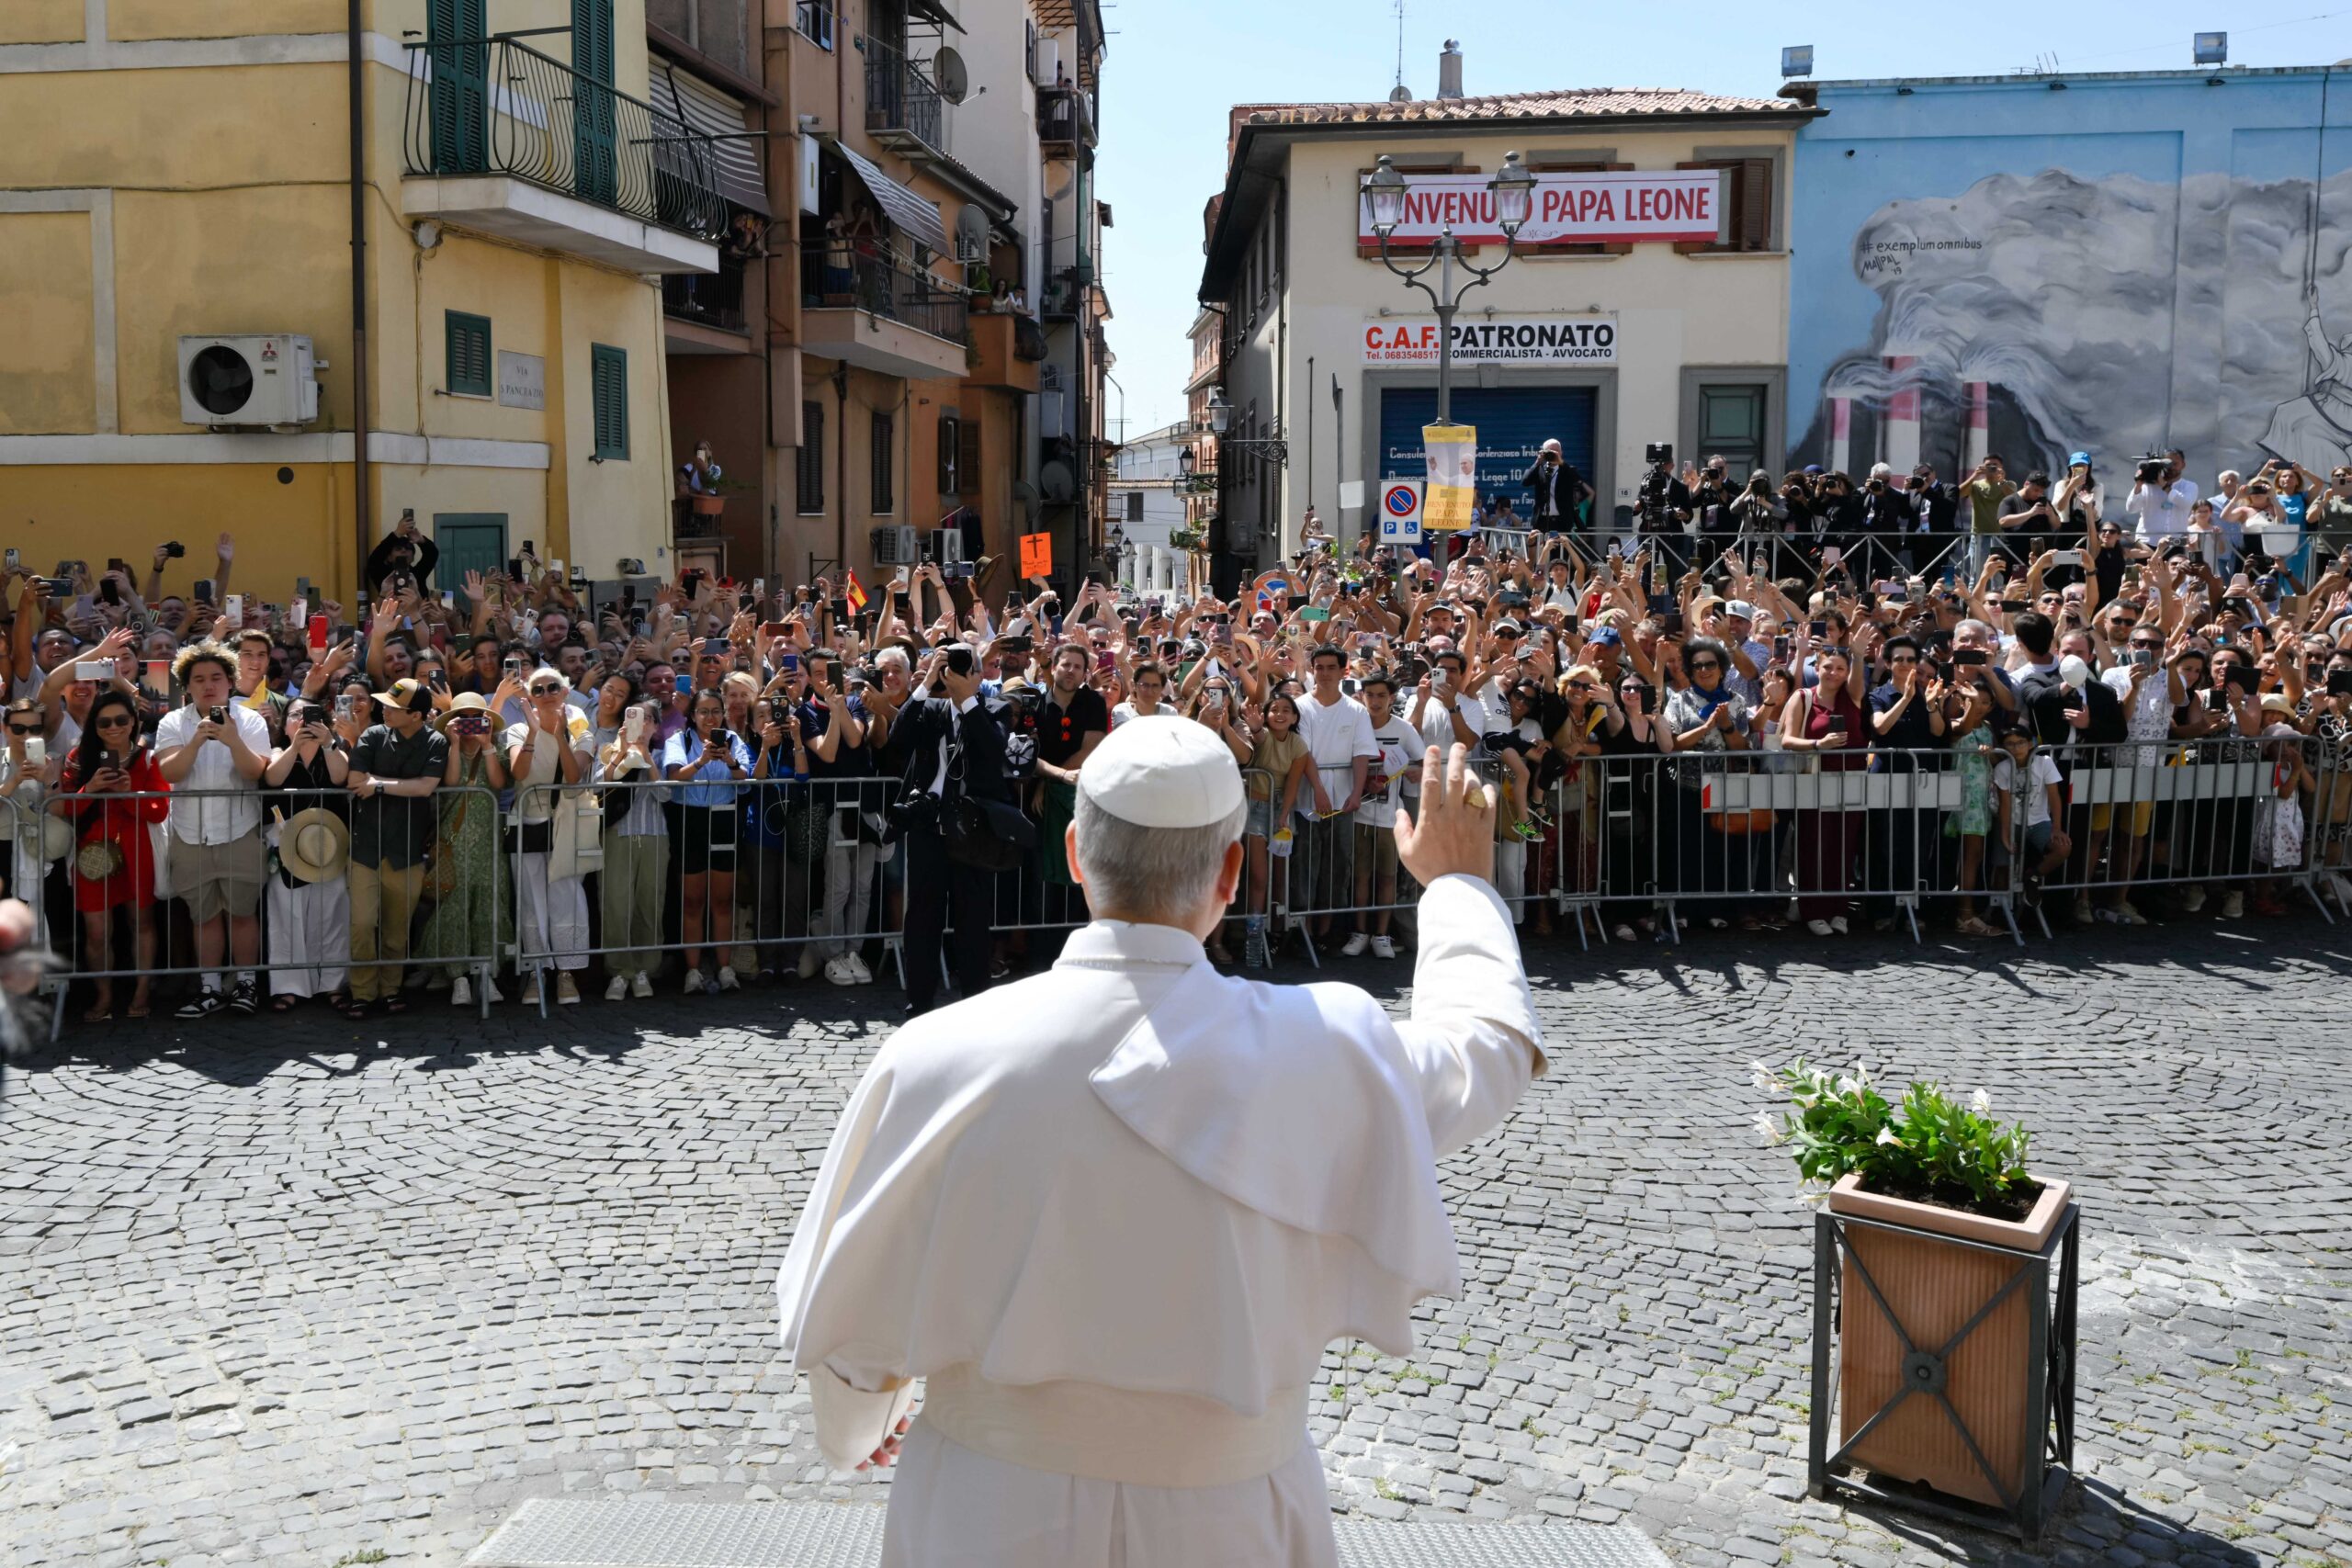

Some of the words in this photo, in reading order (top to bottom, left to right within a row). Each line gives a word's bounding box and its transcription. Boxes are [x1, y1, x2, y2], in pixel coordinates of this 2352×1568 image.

[1543, 189, 1615, 222] PAPA
[1625, 187, 1710, 221] LEONE
[1365, 326, 1440, 349] C.A.F.
[1449, 324, 1614, 348] PATRONATO
[1366, 351, 1382, 360] Tel.
[1385, 351, 1440, 360] 0683548517
[1449, 349, 1543, 359] OMMERCIALISTA
[1552, 348, 1612, 358] AVVOCATO
[515, 366, 528, 376] VIA
[1482, 469, 1508, 487] Legge
[1510, 468, 1522, 481] 10
[1427, 501, 1471, 509] BENVENUTO
[1435, 508, 1460, 517] PAPA
[1431, 518, 1462, 527] LEONE
[1385, 523, 1395, 533] P
